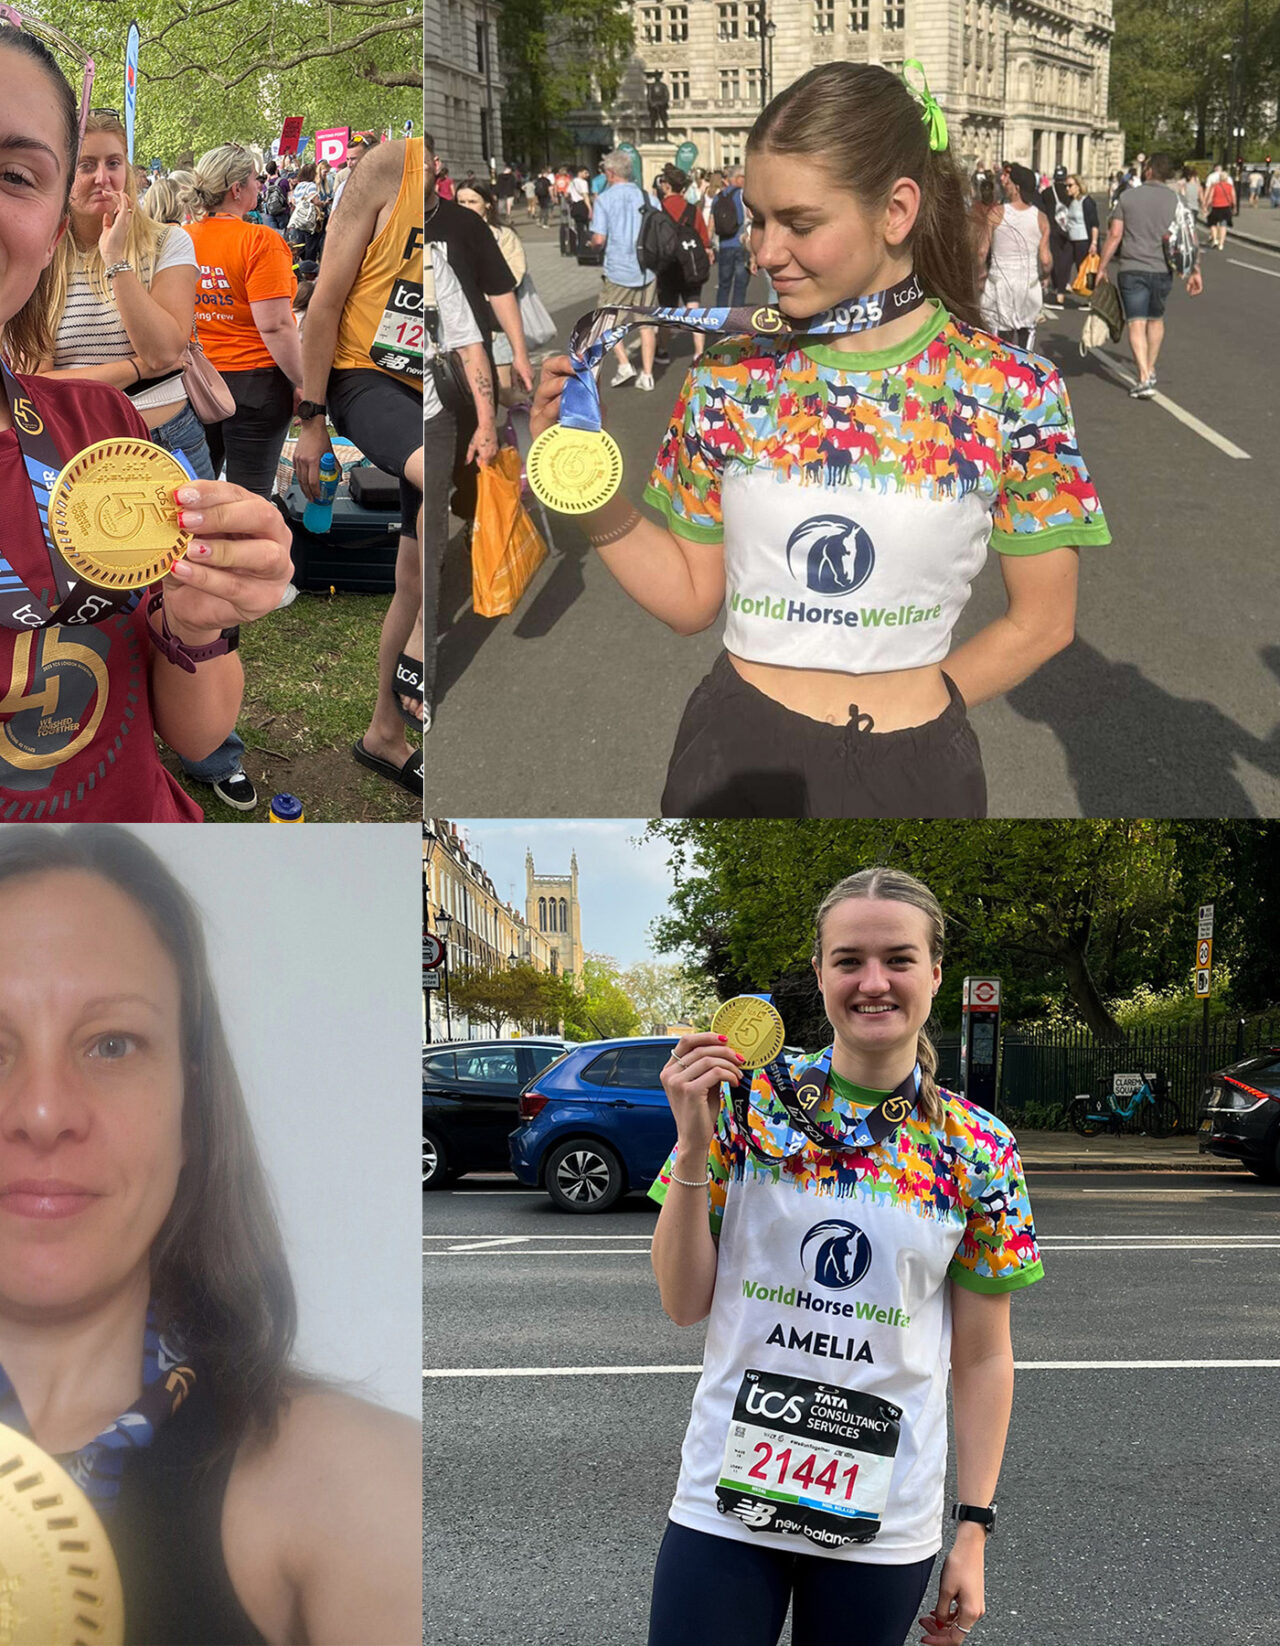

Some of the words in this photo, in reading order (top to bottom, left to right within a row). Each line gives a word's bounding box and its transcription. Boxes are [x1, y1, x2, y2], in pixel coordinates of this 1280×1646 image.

[394, 285, 423, 312] tc
[822, 300, 883, 327] 2025
[893, 286, 917, 307] tcs
[67, 595, 113, 624] tcs
[396, 663, 418, 685] tcs
[38, 722, 80, 737] TOGETHER
[40, 716, 52, 725] WE
[770, 1061, 787, 1092] FINIS
[766, 1323, 874, 1364] AMELIA
[745, 1383, 805, 1424] tcs
[814, 1392, 848, 1410] TATA
[807, 1418, 861, 1439] SERVICES
[810, 1405, 889, 1433] CONSULTANCY
[748, 1441, 860, 1500] 21441
[775, 1517, 802, 1531] new
